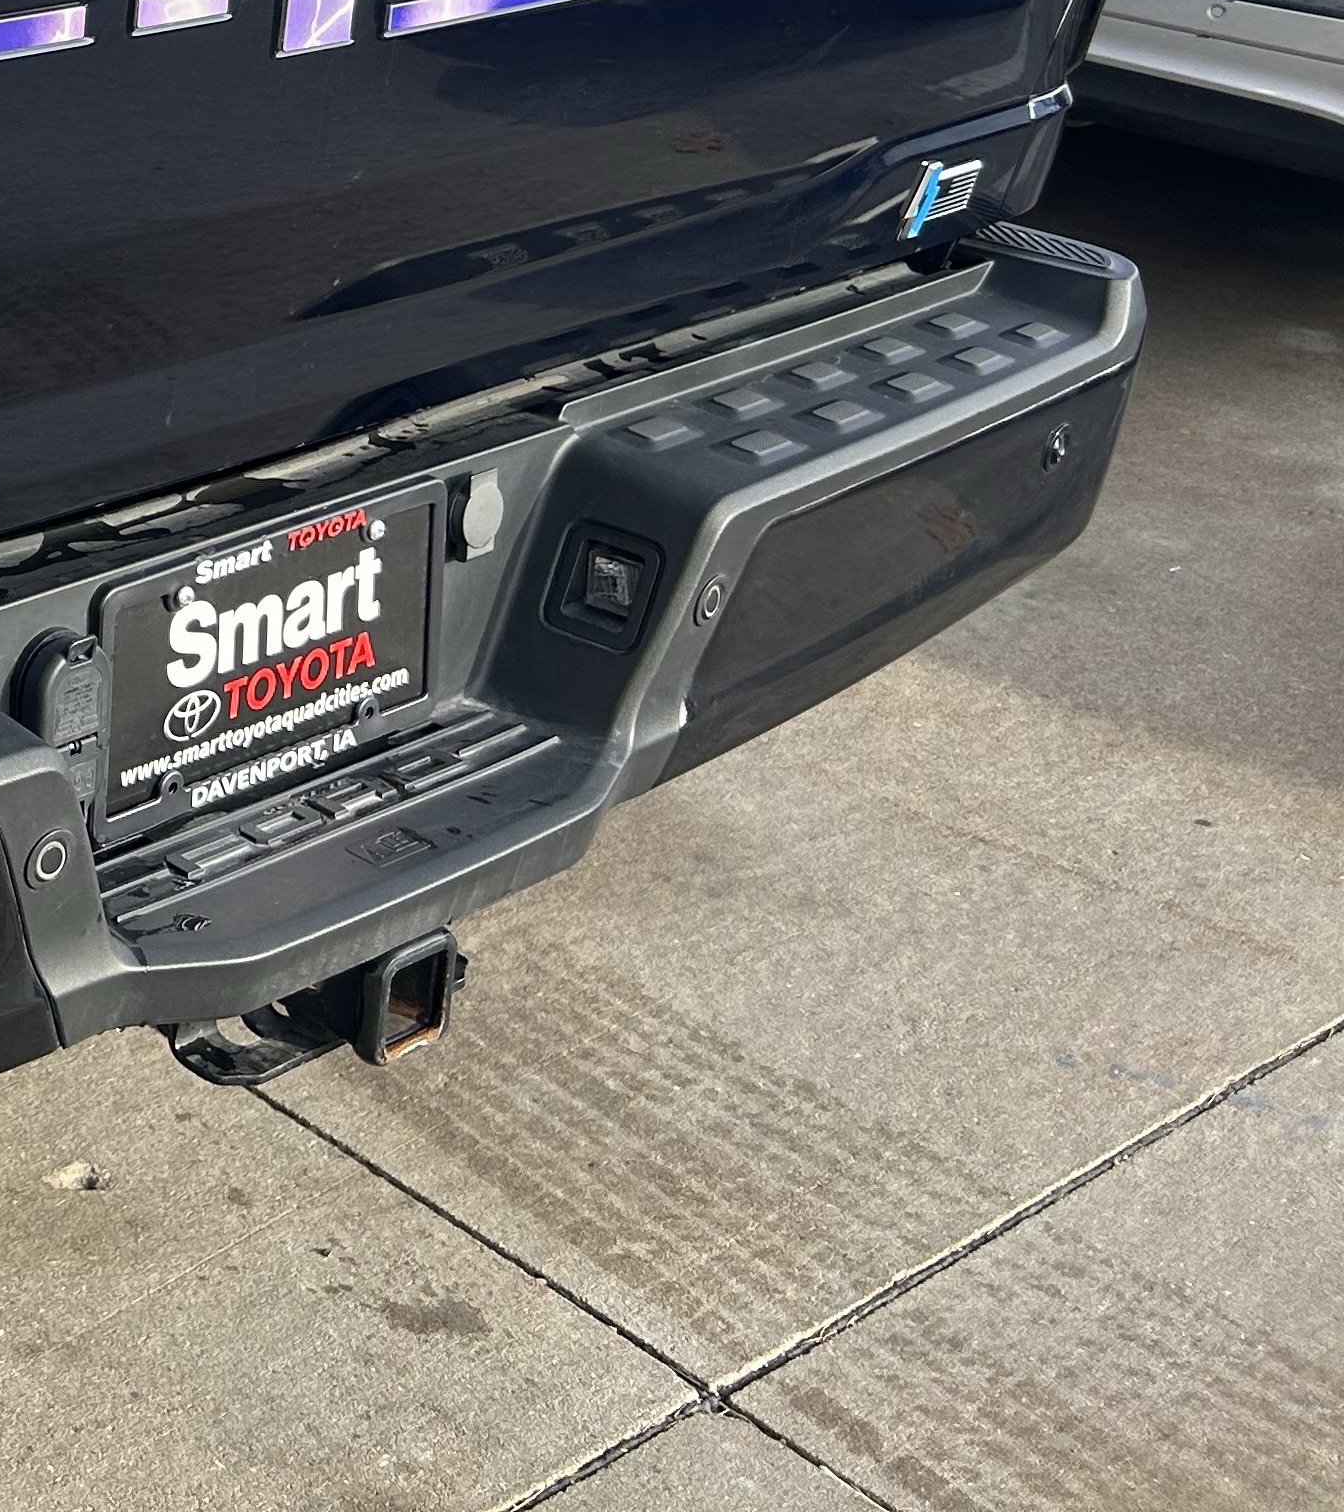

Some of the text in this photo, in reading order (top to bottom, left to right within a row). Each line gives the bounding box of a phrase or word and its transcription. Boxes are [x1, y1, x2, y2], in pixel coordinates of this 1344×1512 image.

[195, 509, 367, 585] Smart TOYOTA
[166, 546, 382, 689] Smart
[223, 631, 376, 719] TOYOTA
[120, 665, 410, 787] www.smarttoyotaquadcities.com
[191, 728, 358, 809] DAVENPORT, IA
